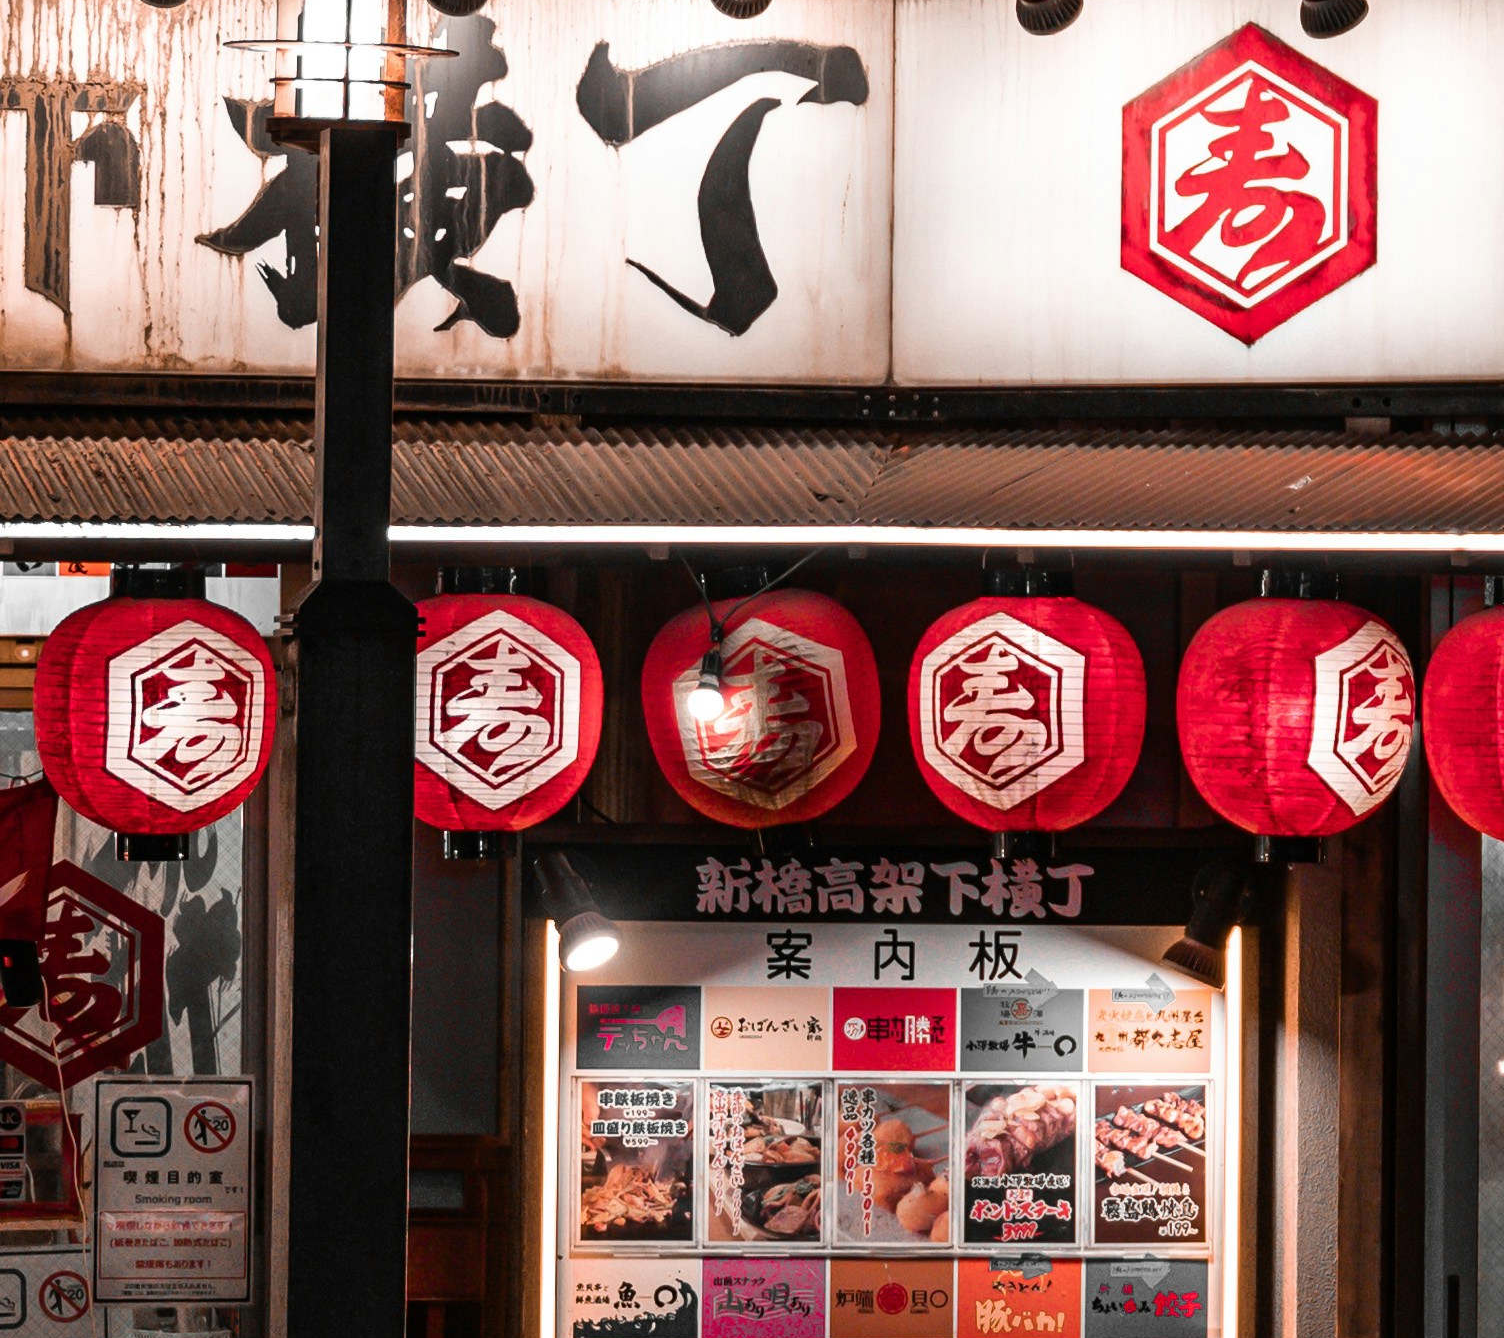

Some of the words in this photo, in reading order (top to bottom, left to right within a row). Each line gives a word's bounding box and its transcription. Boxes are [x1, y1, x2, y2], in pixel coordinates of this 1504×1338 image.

[696, 856, 1096, 918] 新橋高架下横丁
[765, 928, 1024, 982] 案内板
[737, 1015, 823, 1034] おばんざい家
[599, 1089, 677, 1108] 串鉄板焼き
[592, 1120, 688, 1137] 皿盛り鉄板焼き
[0, 1162, 21, 1170] VISA
[123, 1170, 223, 1185] 喫煙目的室
[134, 1194, 181, 1206] Smoking
[184, 1195, 212, 1204] room
[976, 1299, 1065, 1334] 豚バカ!
